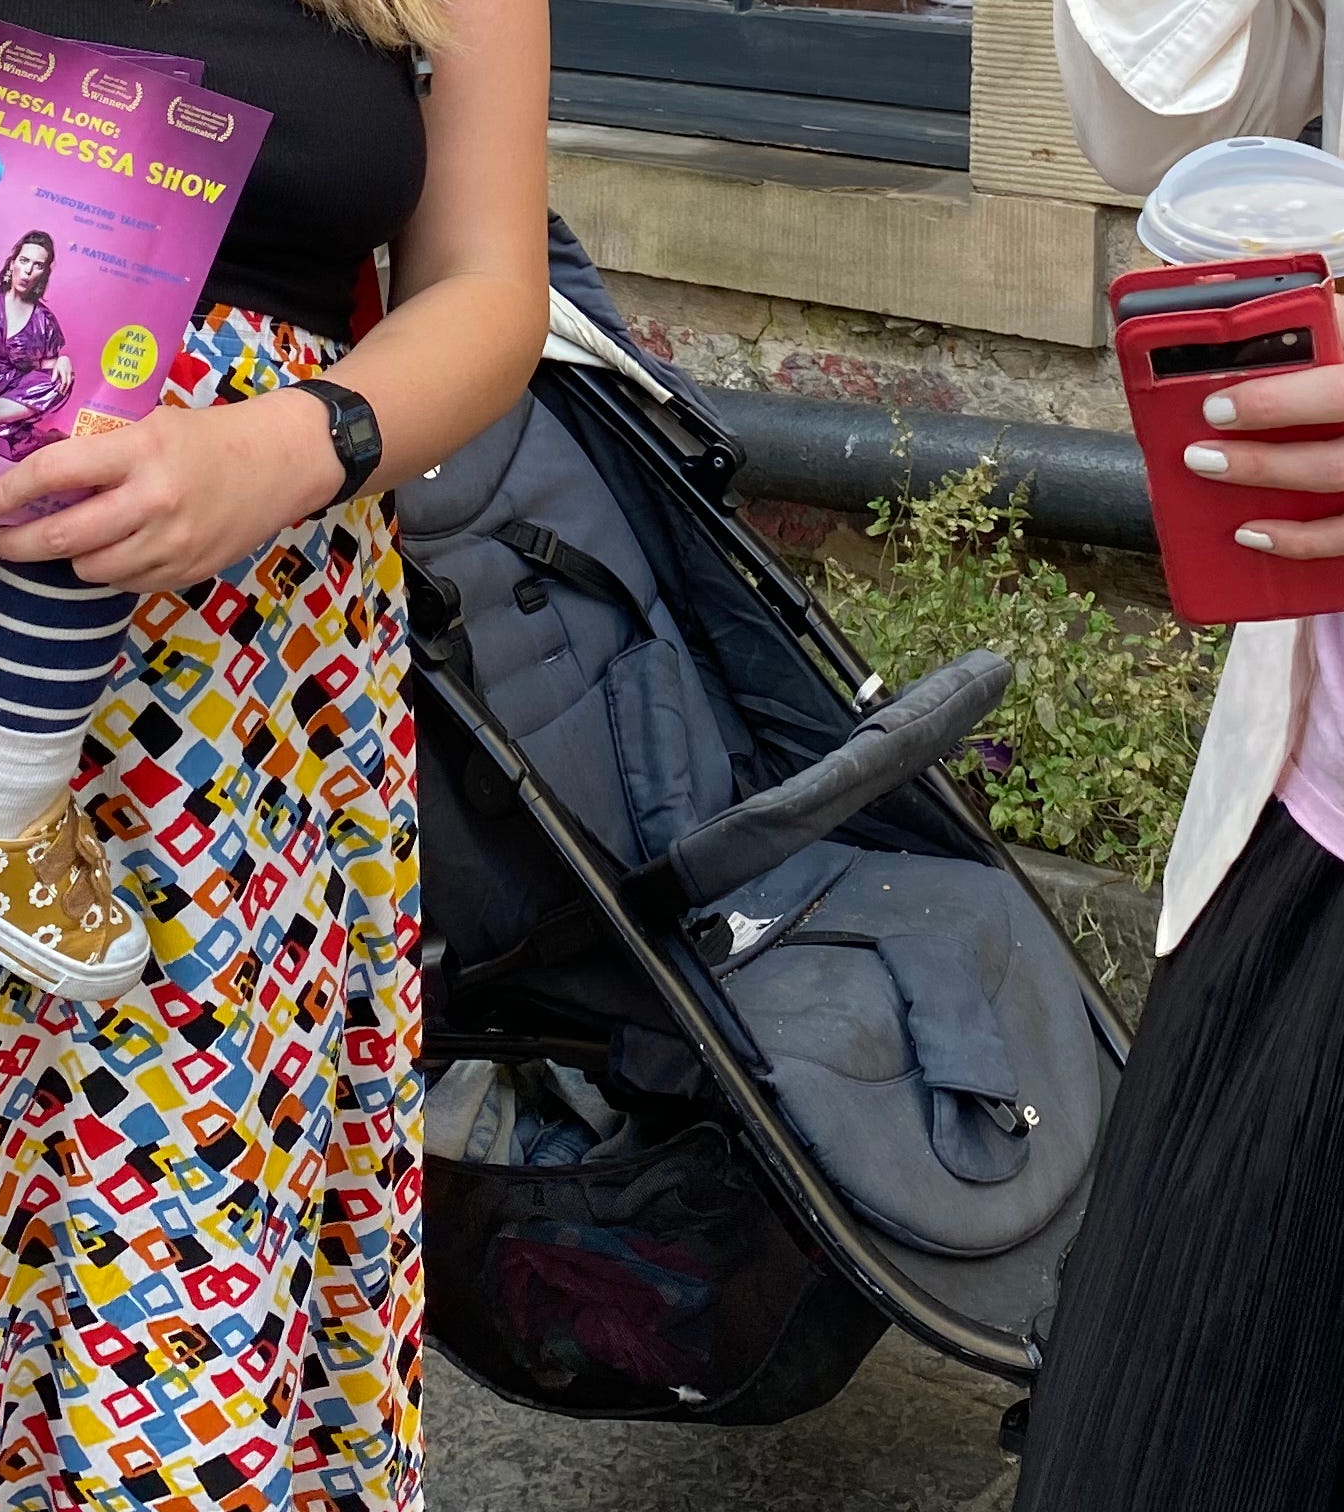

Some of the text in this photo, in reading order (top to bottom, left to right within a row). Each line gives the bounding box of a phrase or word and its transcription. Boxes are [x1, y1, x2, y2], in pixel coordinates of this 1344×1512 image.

[90, 91, 130, 111] Winner
[62, 108, 121, 139] LONG:
[146, 162, 227, 204] SHOW
[125, 330, 147, 343] PAY
[119, 342, 146, 357] WHAT
[117, 356, 139, 370] YOU
